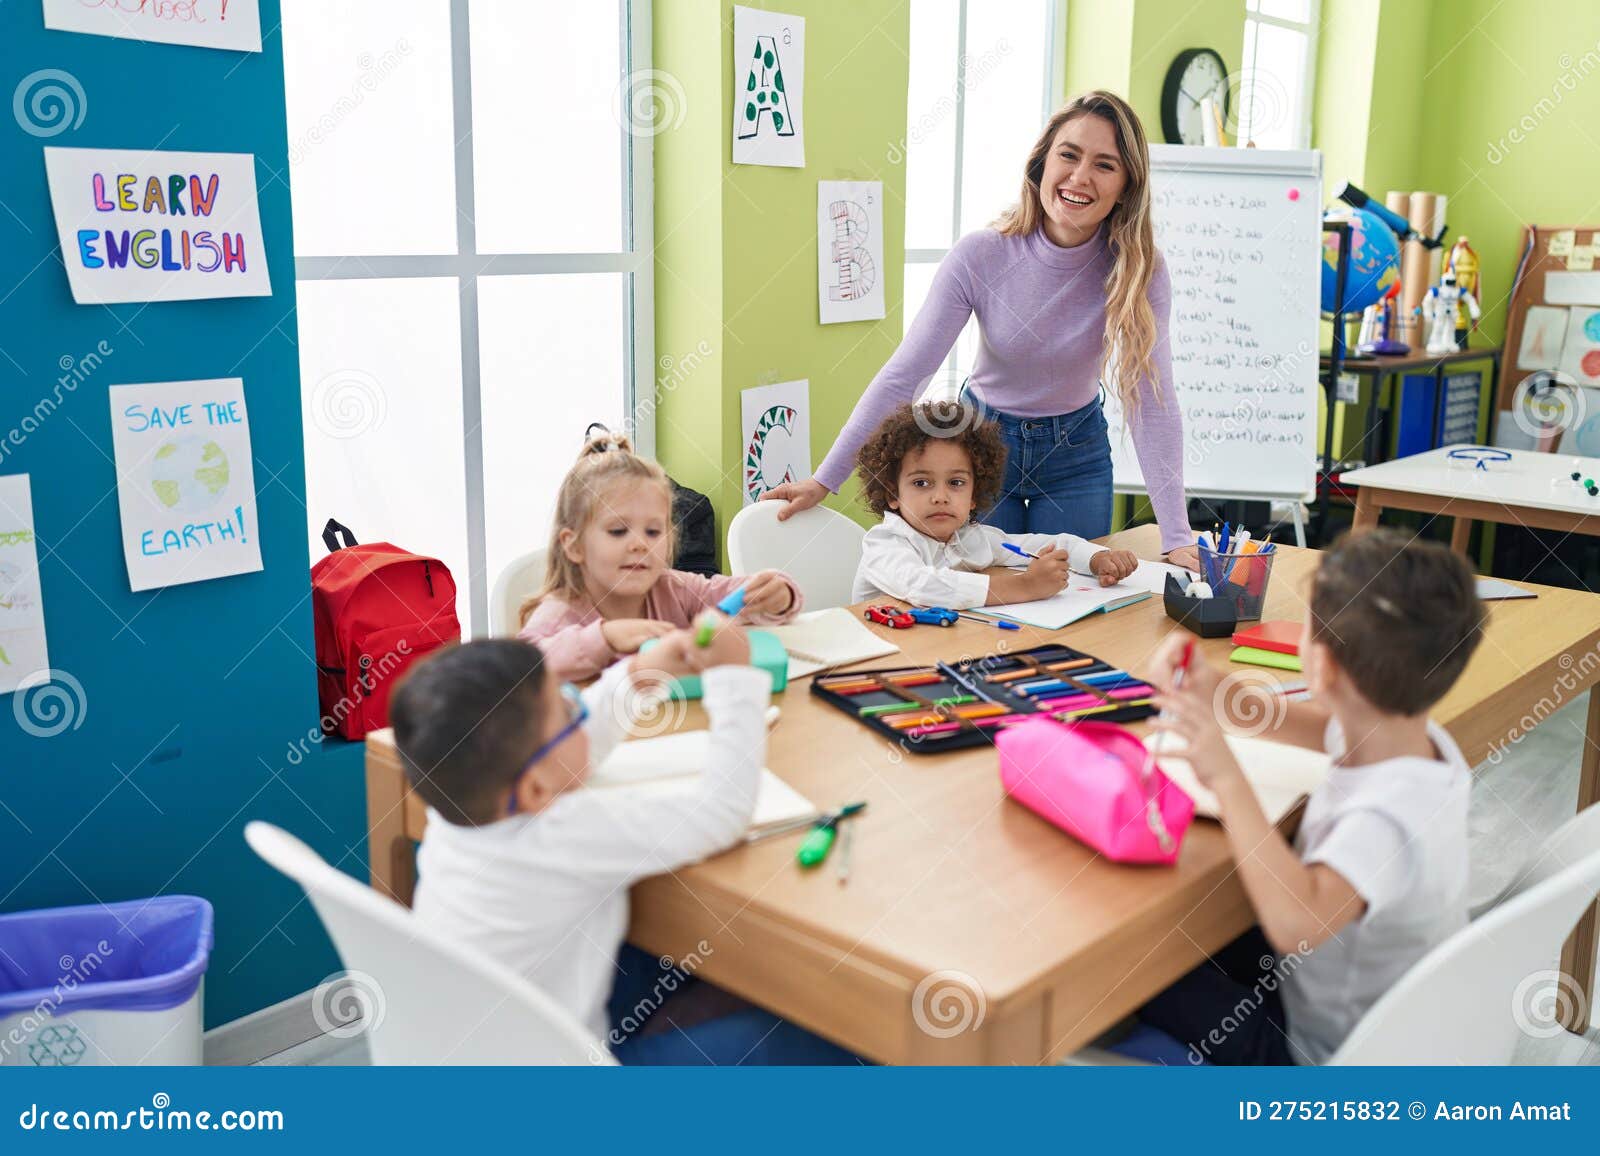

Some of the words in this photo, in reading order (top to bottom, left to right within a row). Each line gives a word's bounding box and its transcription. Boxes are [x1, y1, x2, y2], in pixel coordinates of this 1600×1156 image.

[738, 36, 795, 140] A
[92, 173, 219, 216] LEARN
[77, 229, 247, 274] ENGLISH
[829, 200, 876, 301] B
[124, 404, 193, 433] SAVE
[202, 401, 242, 424] THE
[747, 405, 798, 503] C
[141, 506, 248, 556] EARTH!
